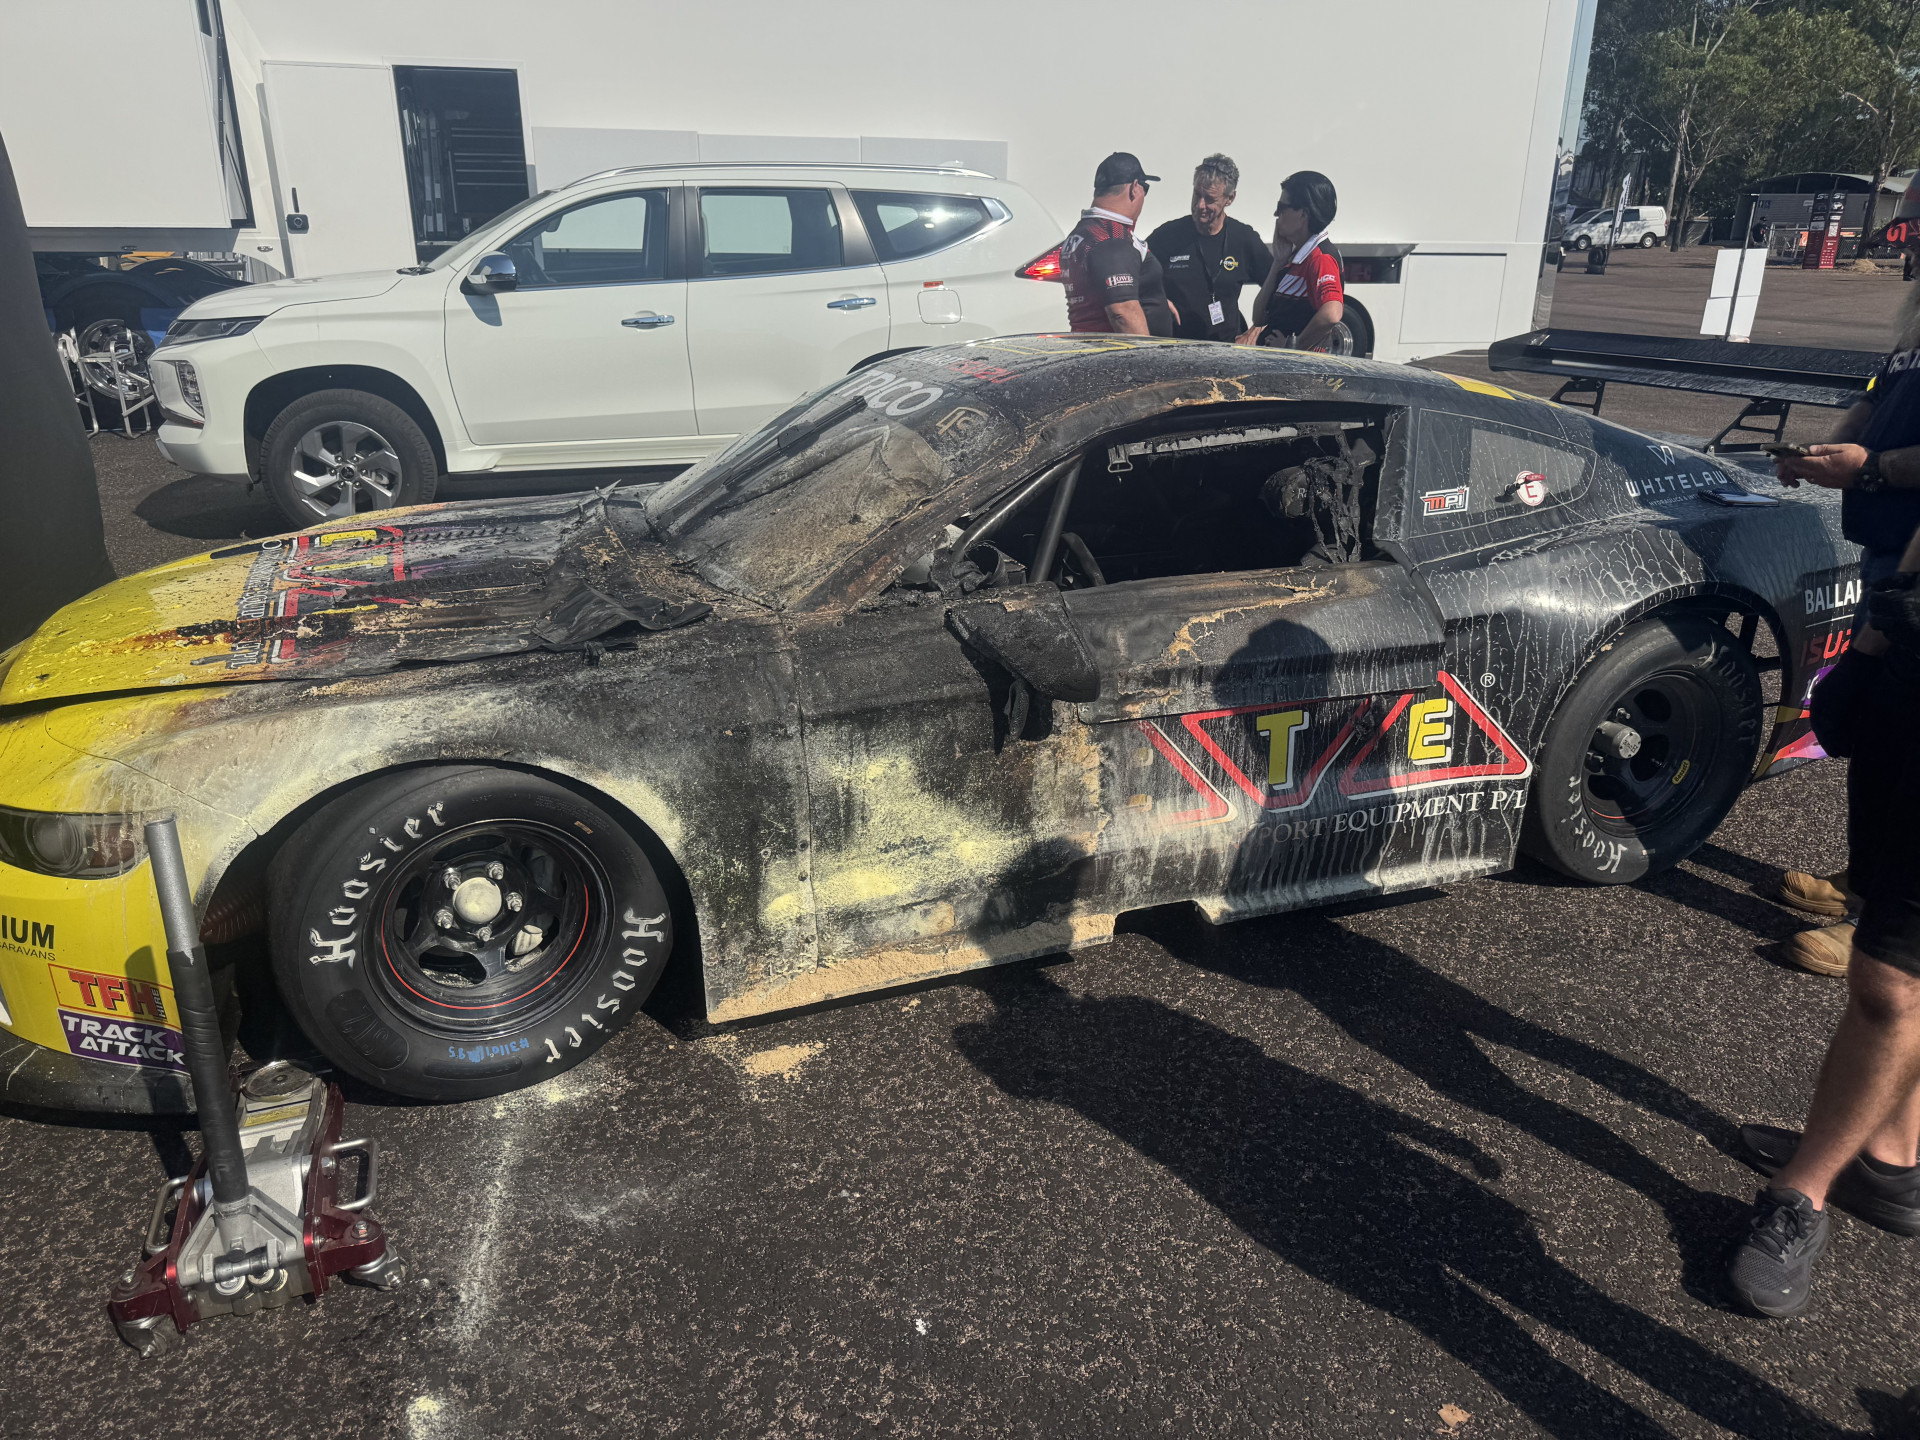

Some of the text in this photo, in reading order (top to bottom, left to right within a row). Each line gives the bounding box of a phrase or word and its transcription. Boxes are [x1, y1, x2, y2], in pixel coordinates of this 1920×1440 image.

[834, 369, 944, 416] TRICO
[1625, 470, 1728, 498] WHITELAW
[1333, 792, 1485, 834] EQUIPMENT
[1489, 789, 1526, 811] P/L
[1561, 776, 1628, 874] Hoosier
[309, 801, 446, 970] Hoosier
[2, 915, 55, 950] IUM
[68, 970, 160, 1017] TFH
[544, 907, 666, 1063] Hoosier
[63, 1016, 169, 1047] TRACK
[79, 1036, 186, 1066] ATTACK
